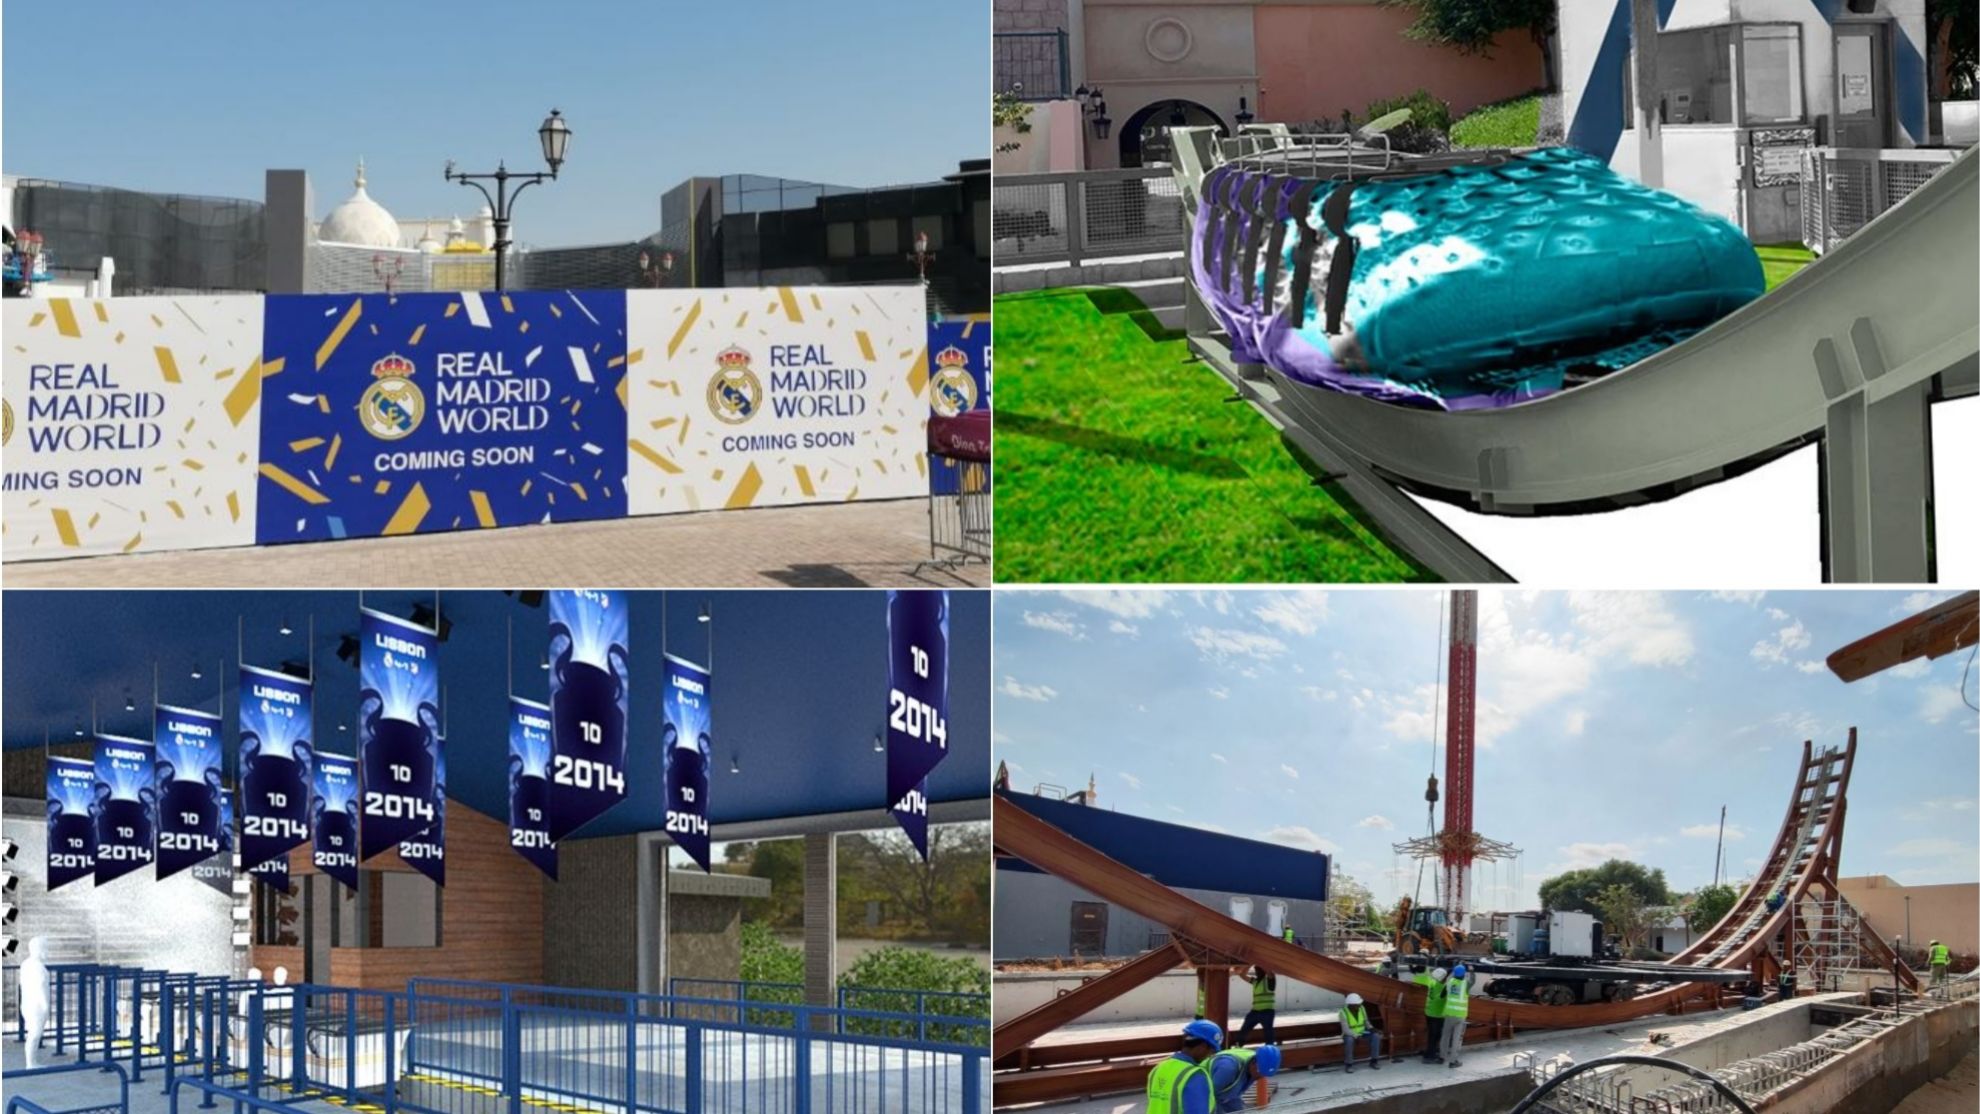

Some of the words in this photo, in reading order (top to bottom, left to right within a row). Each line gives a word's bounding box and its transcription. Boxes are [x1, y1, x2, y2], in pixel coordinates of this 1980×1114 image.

[437, 352, 513, 378] REAL
[770, 344, 834, 367] REAL
[29, 363, 120, 391] REAL
[770, 368, 867, 393] MADRID
[436, 378, 551, 406] MADRID
[28, 391, 165, 422] MADRID
[772, 394, 866, 419] WORLD
[437, 405, 549, 434] WORLD
[28, 422, 162, 453] WORLD
[722, 433, 798, 452] COMING
[803, 431, 855, 449] SOON
[374, 450, 466, 471] COMING
[471, 446, 535, 466] SOON
[68, 467, 143, 488] SOON
[375, 633, 426, 659] LISBON
[911, 646, 929, 679] 10
[254, 685, 300, 704] LISBON
[890, 688, 947, 749] 2014
[580, 721, 601, 744] 10
[390, 765, 412, 782] 10
[554, 754, 625, 794] 2014
[266, 793, 287, 808] 10
[365, 792, 434, 821] 2014
[681, 787, 695, 803] 10
[893, 789, 927, 816] 014
[180, 812, 199, 825] 10
[527, 808, 542, 821] 10
[666, 811, 709, 836] 2014
[117, 827, 134, 838] 10
[244, 816, 308, 839] 2014
[67, 838, 84, 849] 10
[160, 832, 219, 851] 2014
[329, 835, 343, 846] 10
[400, 842, 443, 860] 2014
[97, 845, 152, 861] 2014
[315, 852, 356, 867] 2014
[195, 866, 232, 878] 2014
[249, 861, 288, 873] 014
